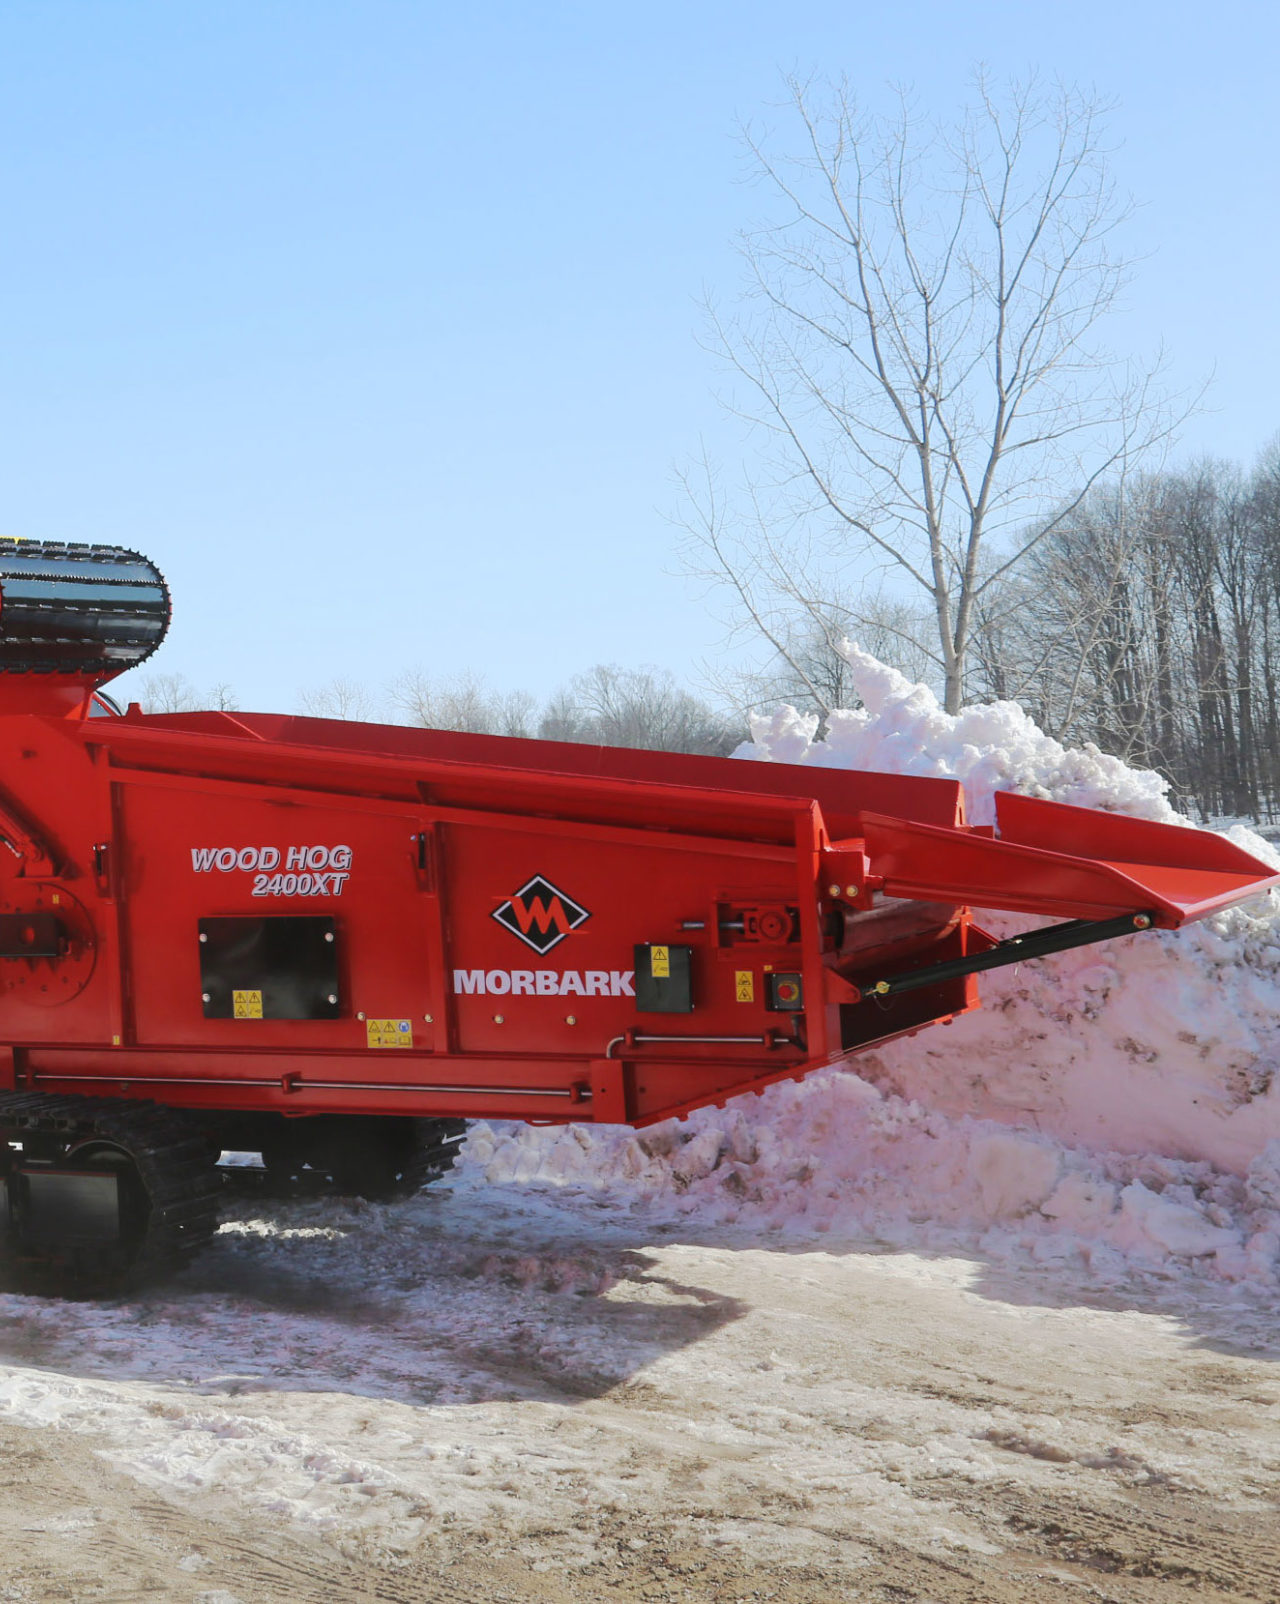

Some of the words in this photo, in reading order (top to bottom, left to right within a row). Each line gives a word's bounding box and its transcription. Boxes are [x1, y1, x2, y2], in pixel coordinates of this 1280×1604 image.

[191, 847, 280, 872] WOOD
[286, 845, 352, 870] HOG
[252, 873, 349, 896] 2400XT
[453, 969, 635, 996] MORBARK
